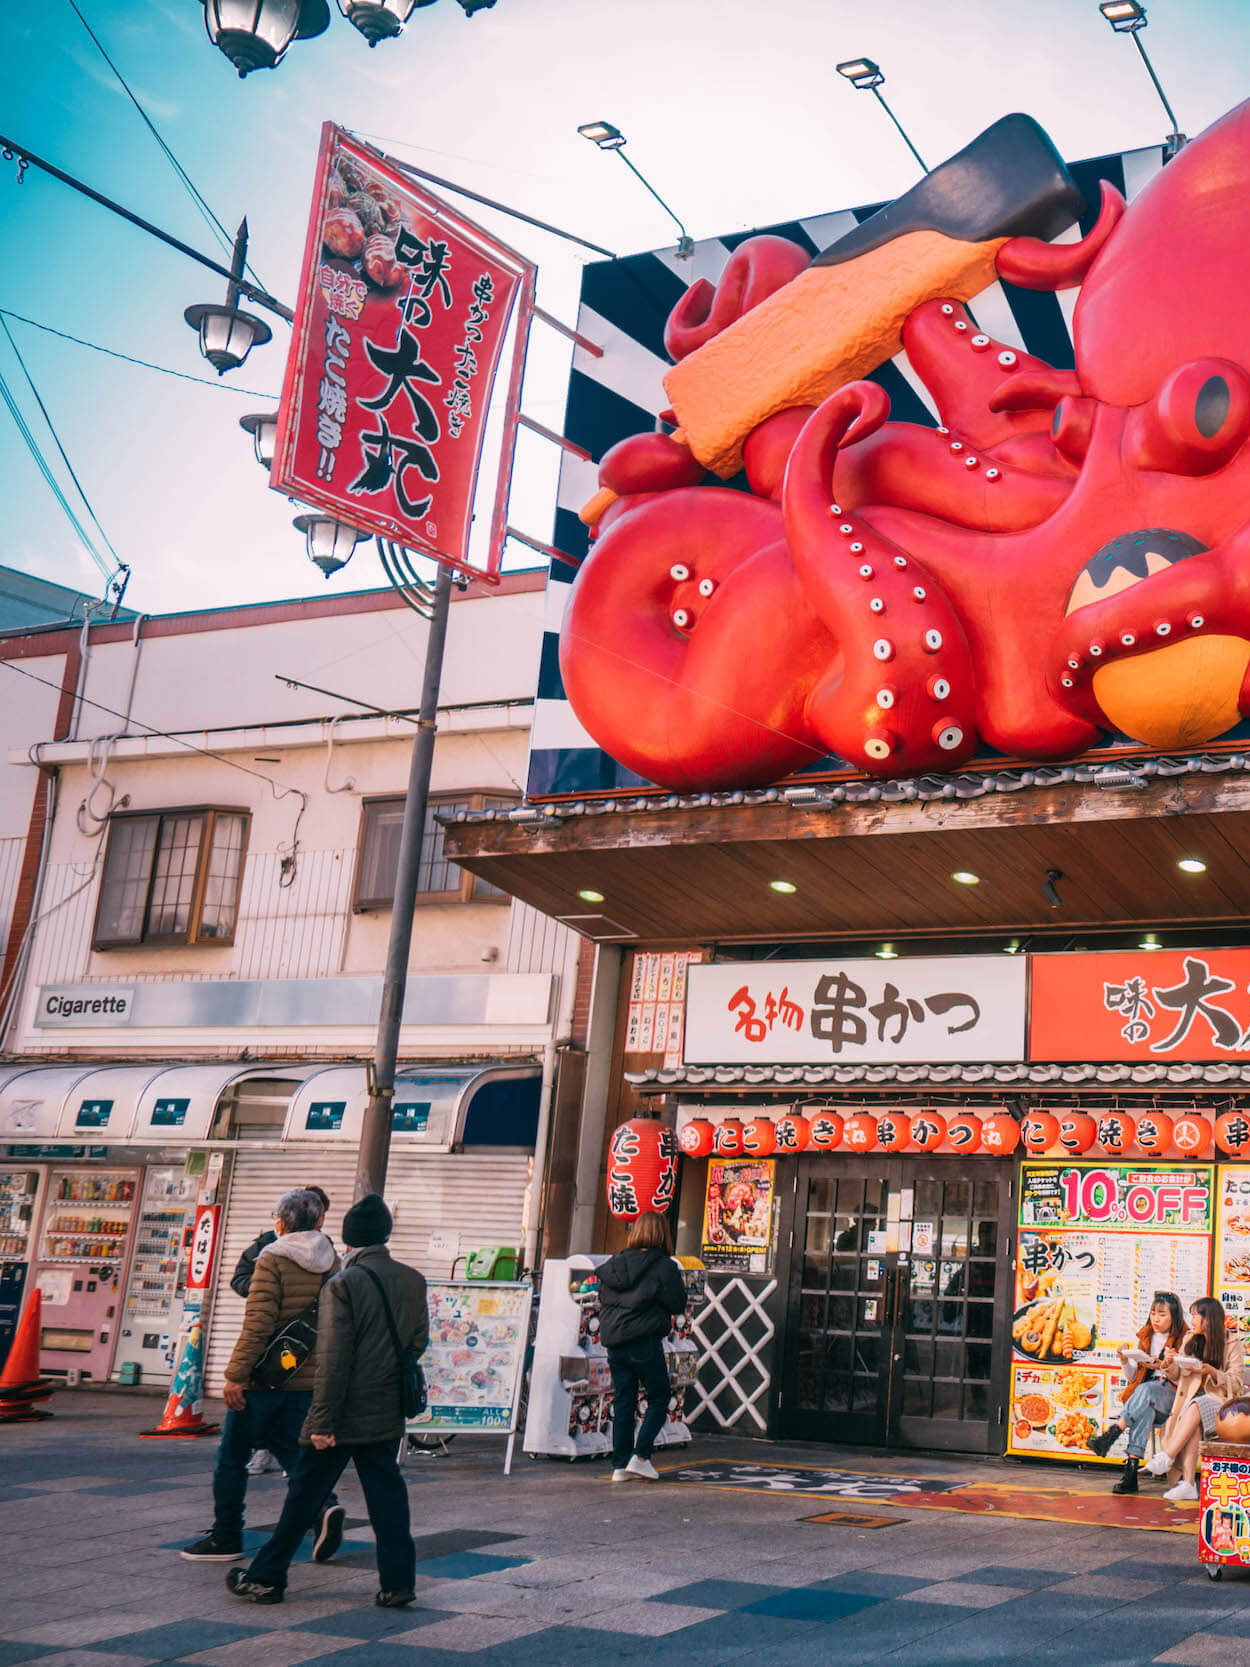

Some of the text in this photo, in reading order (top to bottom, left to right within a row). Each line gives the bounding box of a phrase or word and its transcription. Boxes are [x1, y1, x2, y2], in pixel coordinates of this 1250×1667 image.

[45, 996, 127, 1019] Cigarette
[727, 985, 805, 1042] 名物
[810, 972, 980, 1053] 串かつ
[1103, 976, 1155, 1043] 味の
[1127, 1185, 1209, 1224] OFF
[1022, 1236, 1096, 1275] 串かつ
